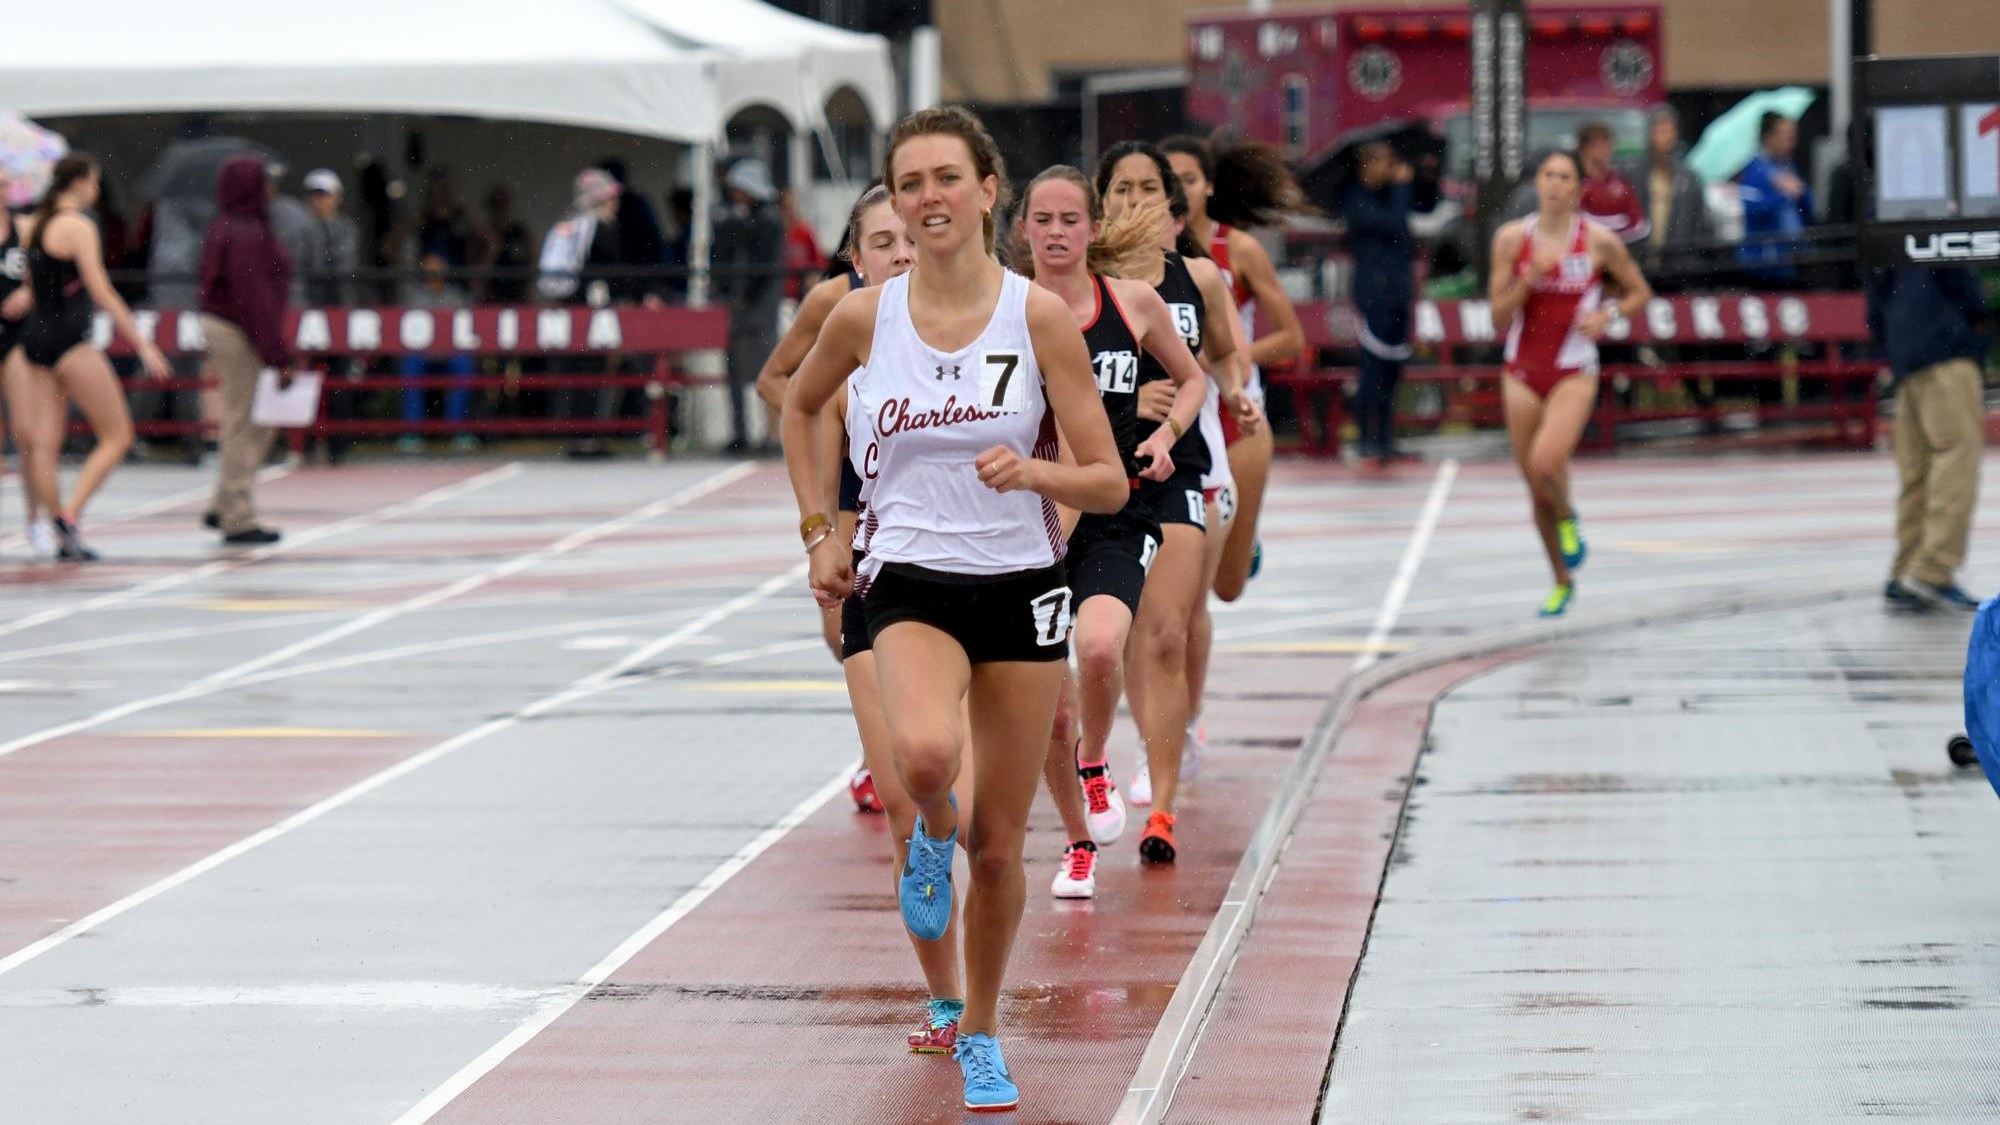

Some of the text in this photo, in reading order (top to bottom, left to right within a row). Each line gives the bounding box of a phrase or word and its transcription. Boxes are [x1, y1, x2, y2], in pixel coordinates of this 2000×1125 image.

[295, 308, 624, 351] AROLINA
[985, 354, 1019, 407] 7
[877, 394, 1019, 437] Charles
[1037, 591, 1067, 640] 7
